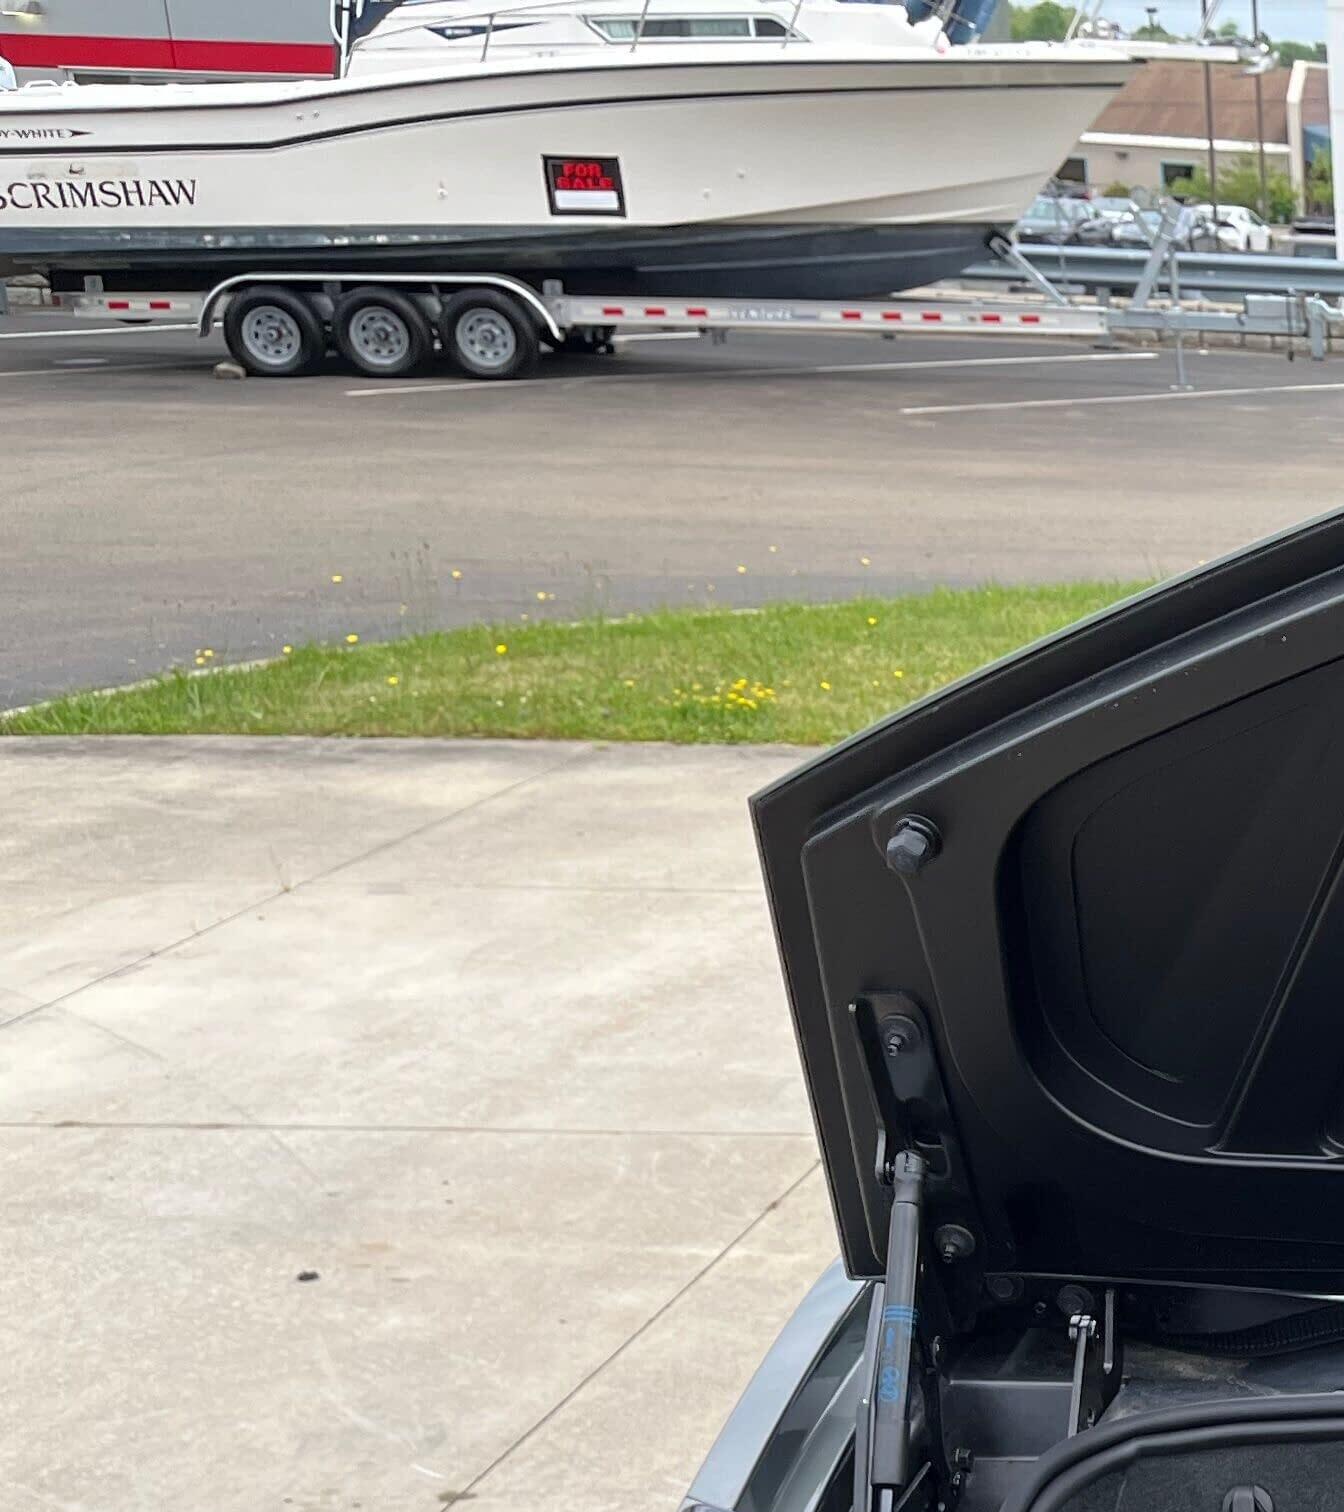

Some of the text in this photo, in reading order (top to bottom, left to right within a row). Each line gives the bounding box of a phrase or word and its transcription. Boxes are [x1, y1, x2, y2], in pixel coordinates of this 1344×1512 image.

[0, 128, 66, 139] Y-WHITE
[563, 162, 602, 177] FOR
[556, 177, 613, 190] SALE
